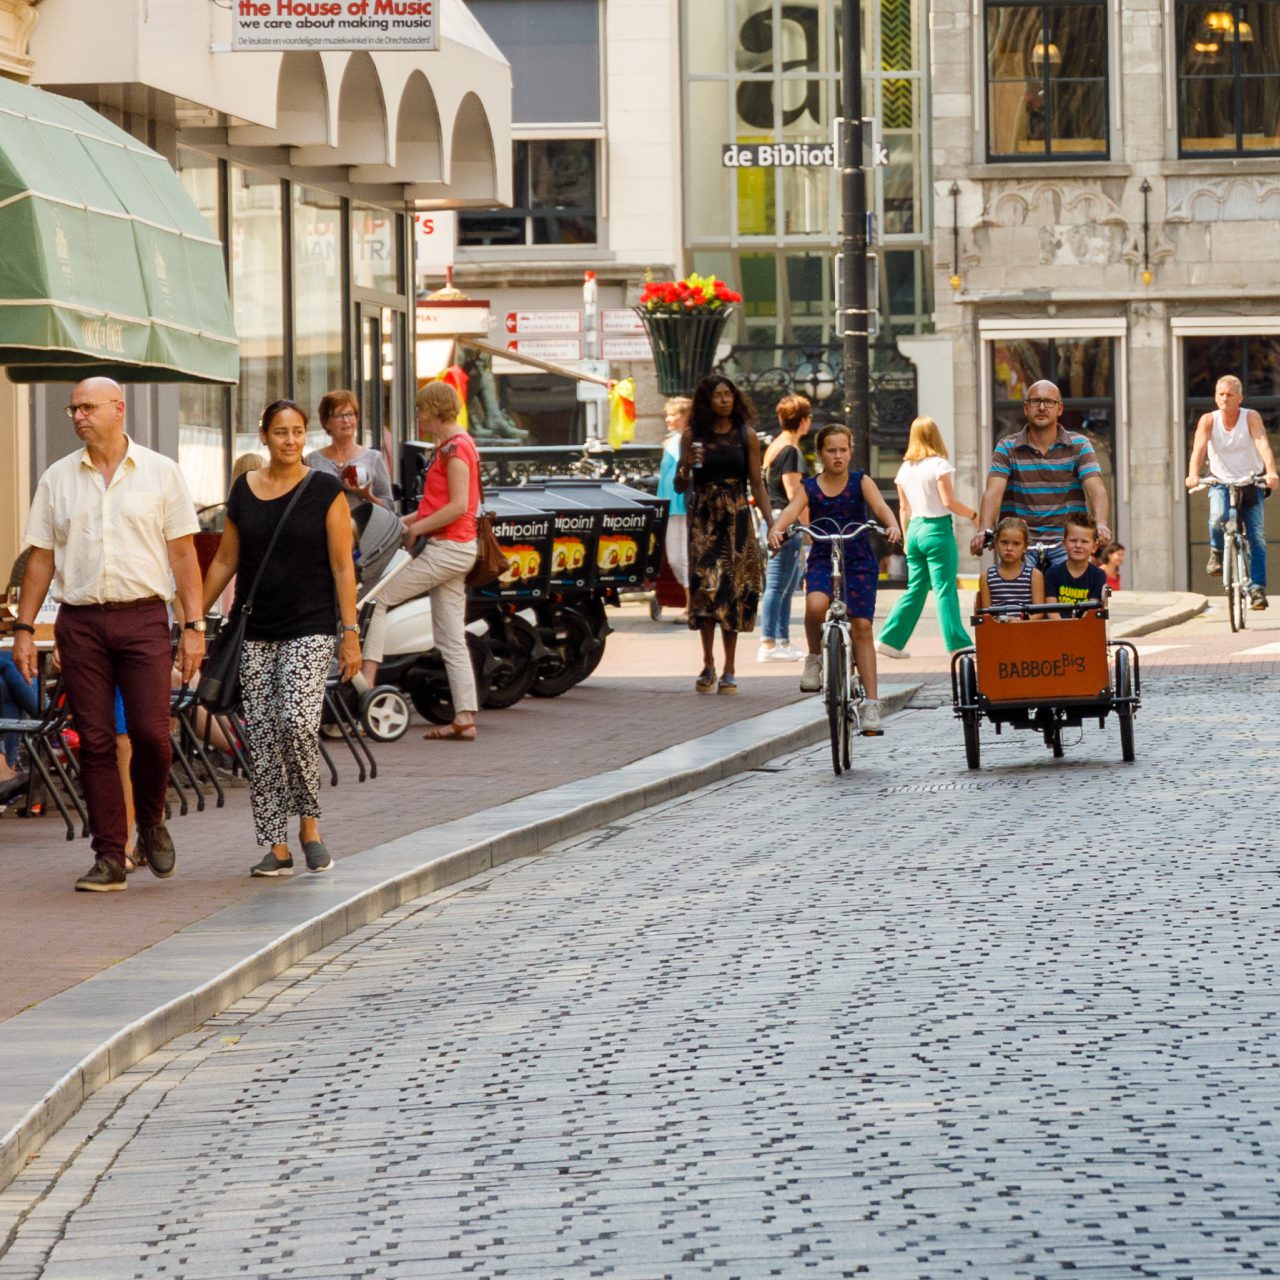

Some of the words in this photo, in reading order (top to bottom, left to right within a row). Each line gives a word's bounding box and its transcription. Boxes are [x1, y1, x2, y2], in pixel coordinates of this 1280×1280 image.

[239, 20, 260, 29] we
[264, 20, 292, 29] care
[296, 17, 335, 28] about
[338, 16, 388, 31] making
[723, 144, 753, 166] de
[758, 143, 889, 166] Bibliotk
[1059, 586, 1089, 599] SUNNY
[998, 659, 1066, 680] BABBOE
